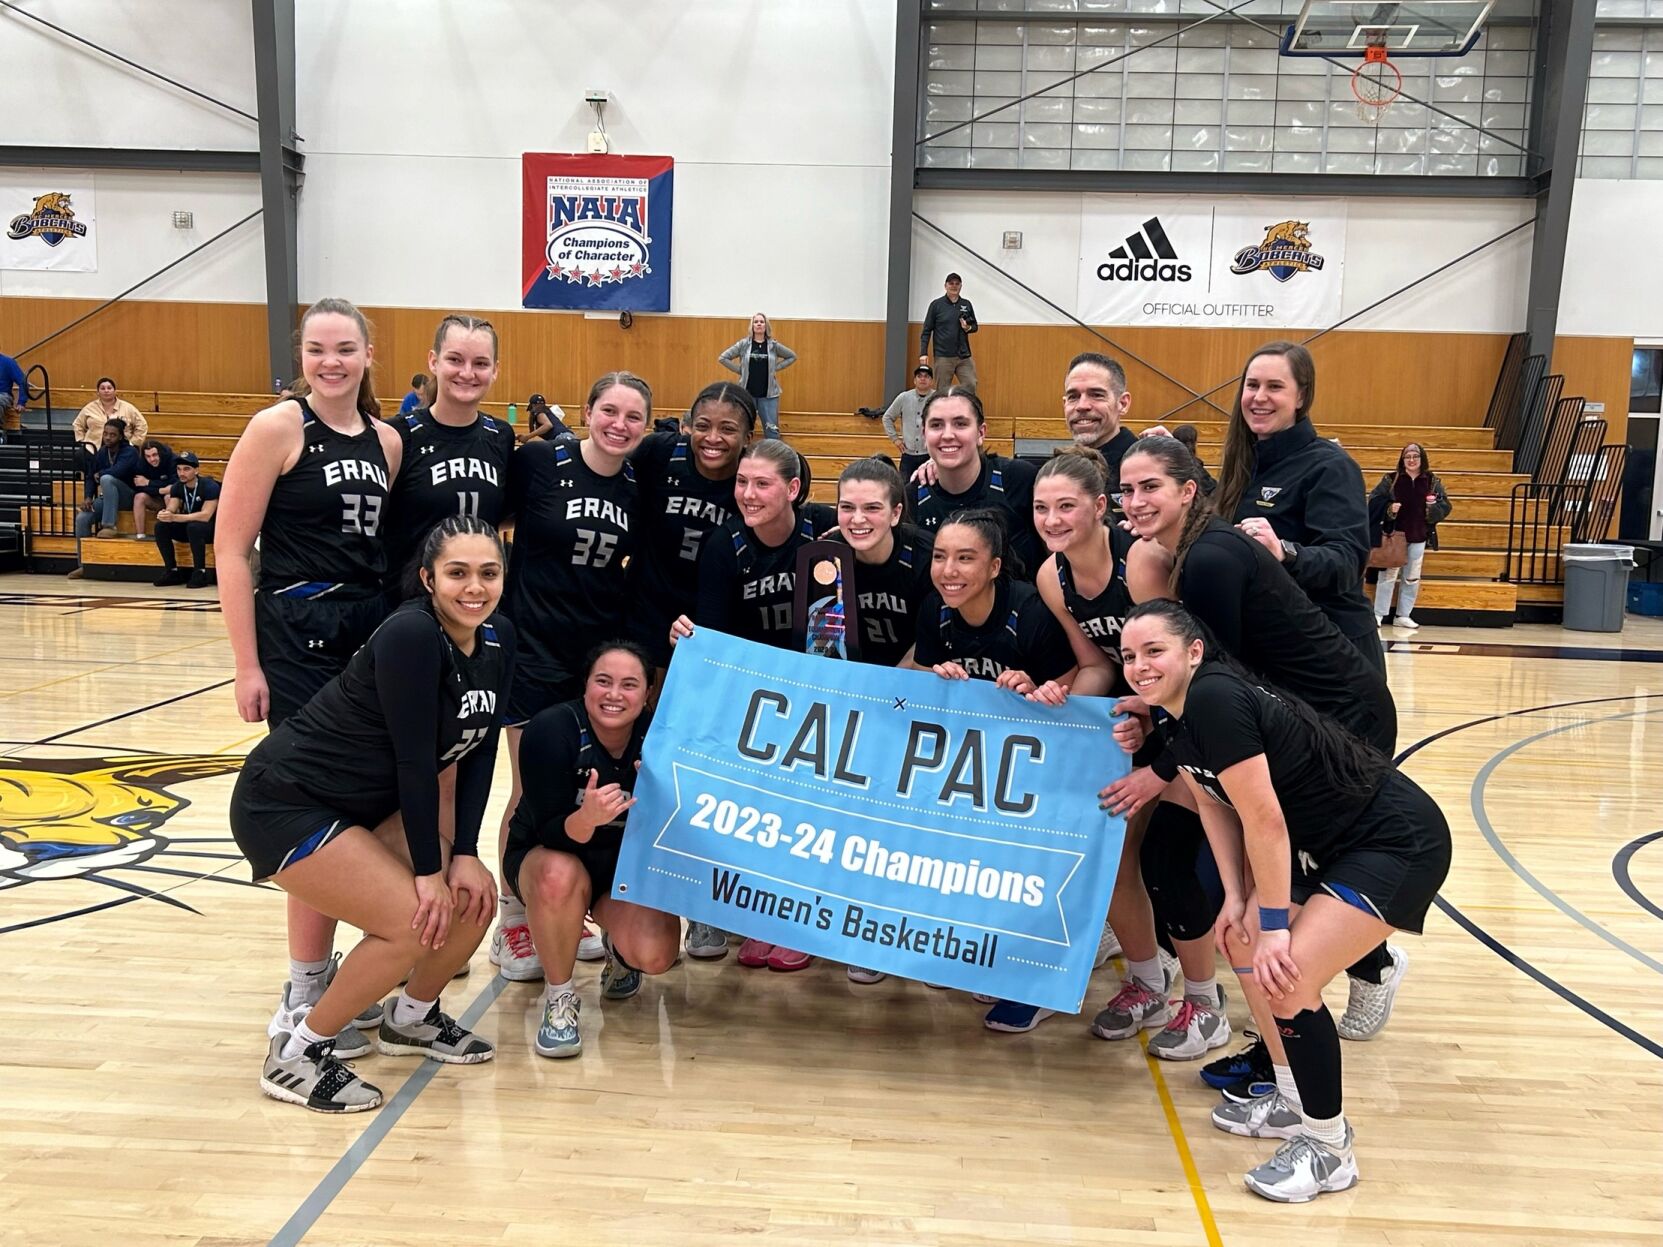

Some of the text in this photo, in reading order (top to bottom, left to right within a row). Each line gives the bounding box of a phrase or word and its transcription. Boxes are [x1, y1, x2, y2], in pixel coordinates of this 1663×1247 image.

[551, 196, 643, 234] NAIA
[558, 250, 635, 262] of Character
[562, 237, 630, 250] Champions
[1097, 258, 1192, 282] adidas
[1143, 302, 1274, 317] OFFICIAL OUTFITTER
[322, 458, 389, 492] ERAU
[430, 457, 498, 487] ERAU
[341, 493, 382, 537] 33
[566, 497, 629, 532] ERAU
[571, 528, 618, 568] 35
[680, 527, 703, 561] 5
[743, 572, 796, 600] ERA
[759, 602, 793, 631] 10
[858, 592, 907, 614] RAU
[864, 617, 898, 643] 21
[457, 690, 496, 719] ERAU
[737, 689, 1046, 818] CAL PAC
[689, 793, 1046, 907] 2023-24 Champions
[711, 868, 998, 968] Women's Basketball
